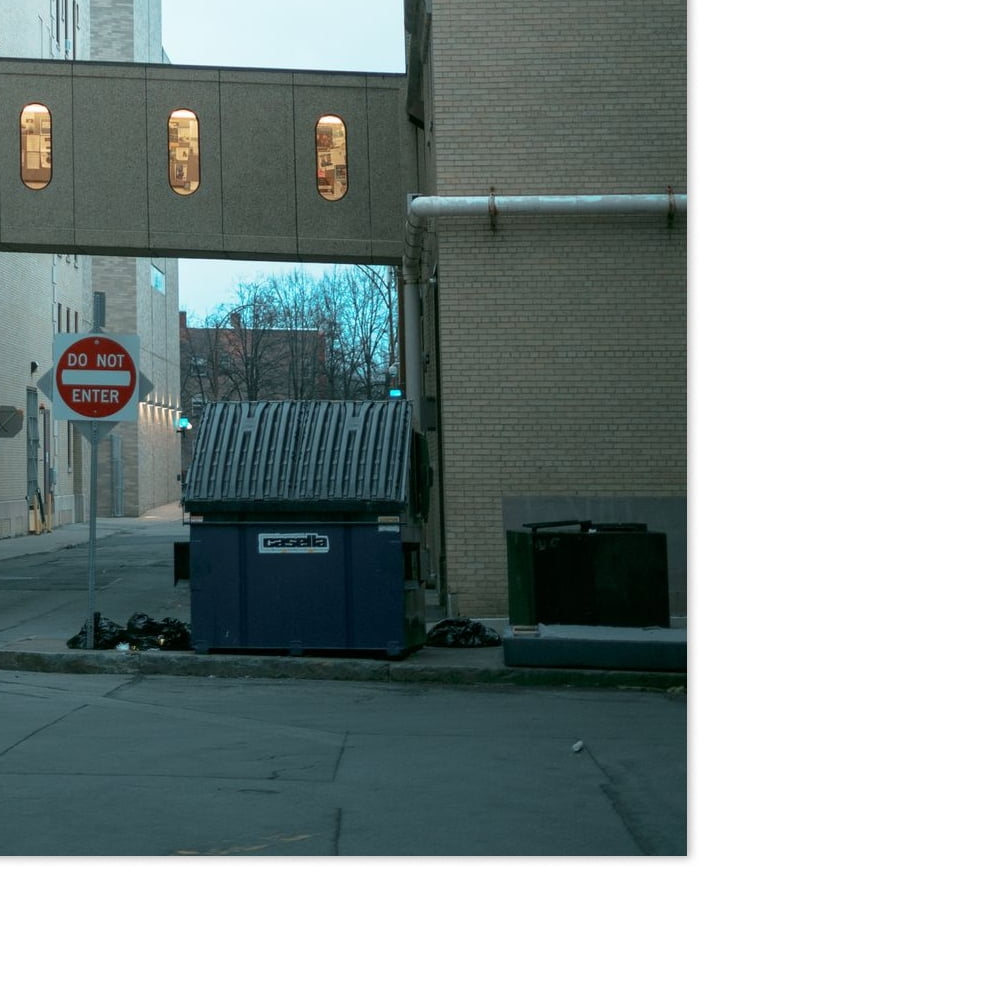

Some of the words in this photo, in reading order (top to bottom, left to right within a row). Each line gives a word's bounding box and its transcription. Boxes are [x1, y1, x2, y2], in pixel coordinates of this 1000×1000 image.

[67, 353, 88, 367] DO
[96, 353, 125, 368] NOT
[72, 388, 119, 403] ENTER
[263, 534, 328, 548] casella
